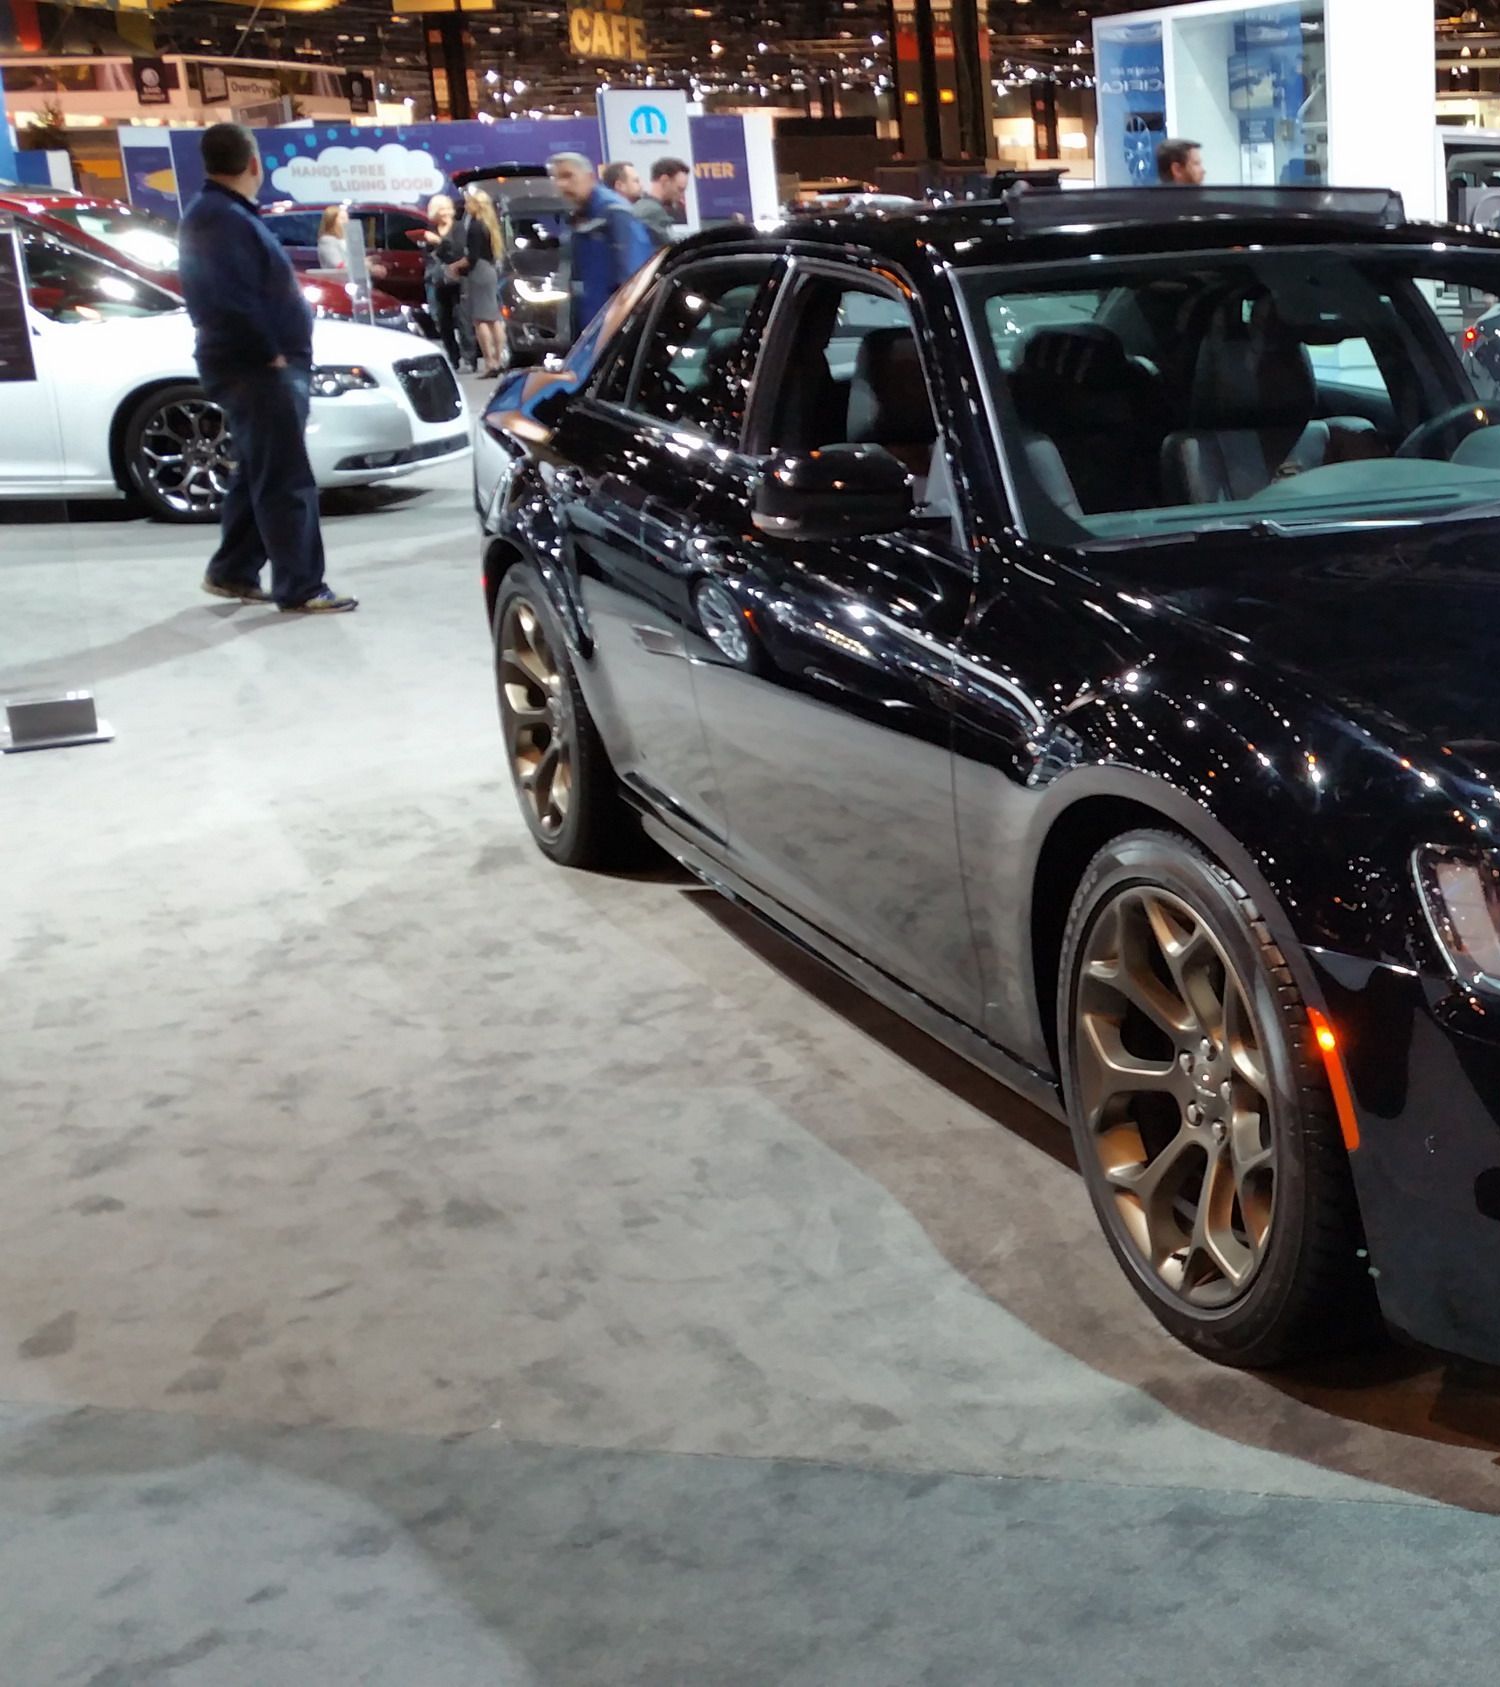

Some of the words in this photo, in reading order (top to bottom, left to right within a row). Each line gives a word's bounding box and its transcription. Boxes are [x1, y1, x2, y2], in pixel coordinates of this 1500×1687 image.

[570, 8, 647, 60] CAFE
[291, 165, 385, 177] HANDS-FREE
[330, 180, 387, 192] SLIDING
[391, 178, 433, 191] DOOR
